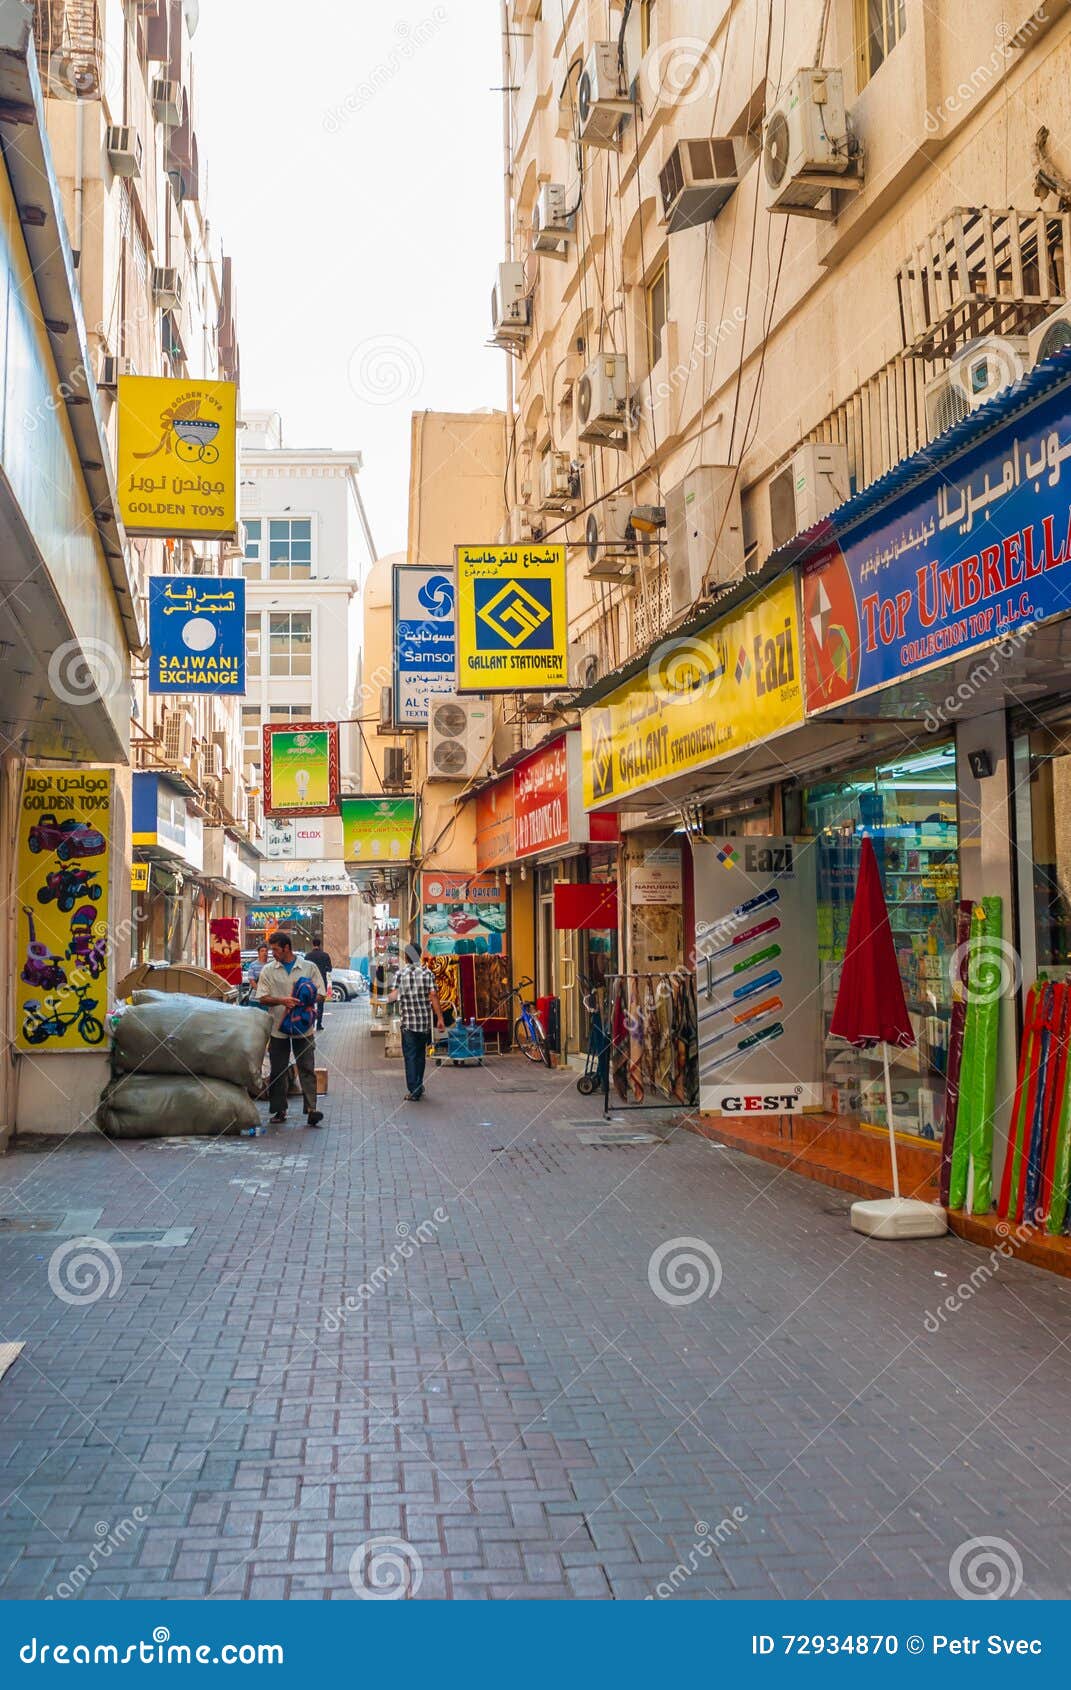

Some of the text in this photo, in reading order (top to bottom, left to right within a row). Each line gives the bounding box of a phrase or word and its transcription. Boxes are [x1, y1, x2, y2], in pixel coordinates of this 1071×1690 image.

[128, 502, 225, 517] GOLDEN TOYS
[464, 550, 559, 568] الشجاع للقرطاسية
[165, 584, 235, 602] صرافة
[163, 601, 235, 616] السجواني
[900, 620, 968, 668] COLLECTION
[969, 607, 994, 638] TOP
[159, 656, 239, 670] SAJWANI
[467, 654, 563, 670] GALLANT STATIONERY
[753, 616, 795, 697] Eazi
[159, 670, 239, 685] EXCHANGE
[405, 698, 420, 708] AL
[619, 725, 669, 784] GALLANT
[671, 721, 717, 765] STATIONERY
[974, 756, 984, 773] 2
[24, 795, 109, 810] GOLDEN TOYS
[745, 844, 793, 872] Eazi
[721, 1094, 799, 1112] GEST
